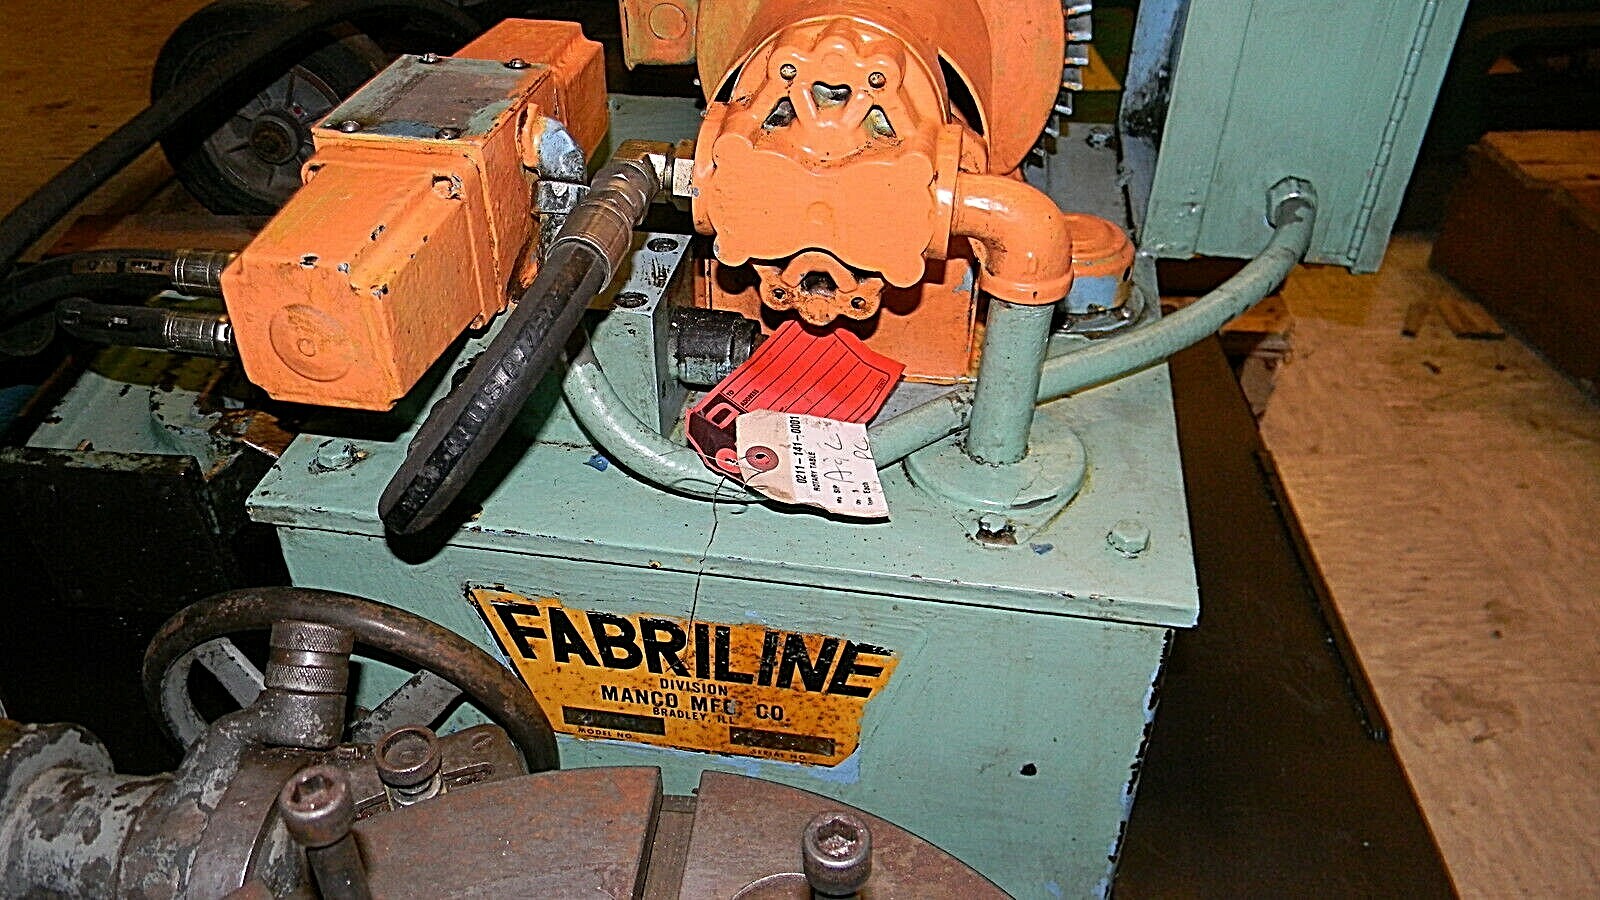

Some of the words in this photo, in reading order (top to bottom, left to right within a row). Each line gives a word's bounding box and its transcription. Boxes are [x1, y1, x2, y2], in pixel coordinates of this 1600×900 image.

[808, 451, 817, 469] TABLE
[811, 470, 821, 492] ROTARY
[491, 600, 897, 698] FABRILINE
[600, 684, 679, 709] MANCO
[659, 678, 729, 697] DIVISION
[578, 727, 612, 737] MODEL
[750, 748, 784, 758] SERIAL
